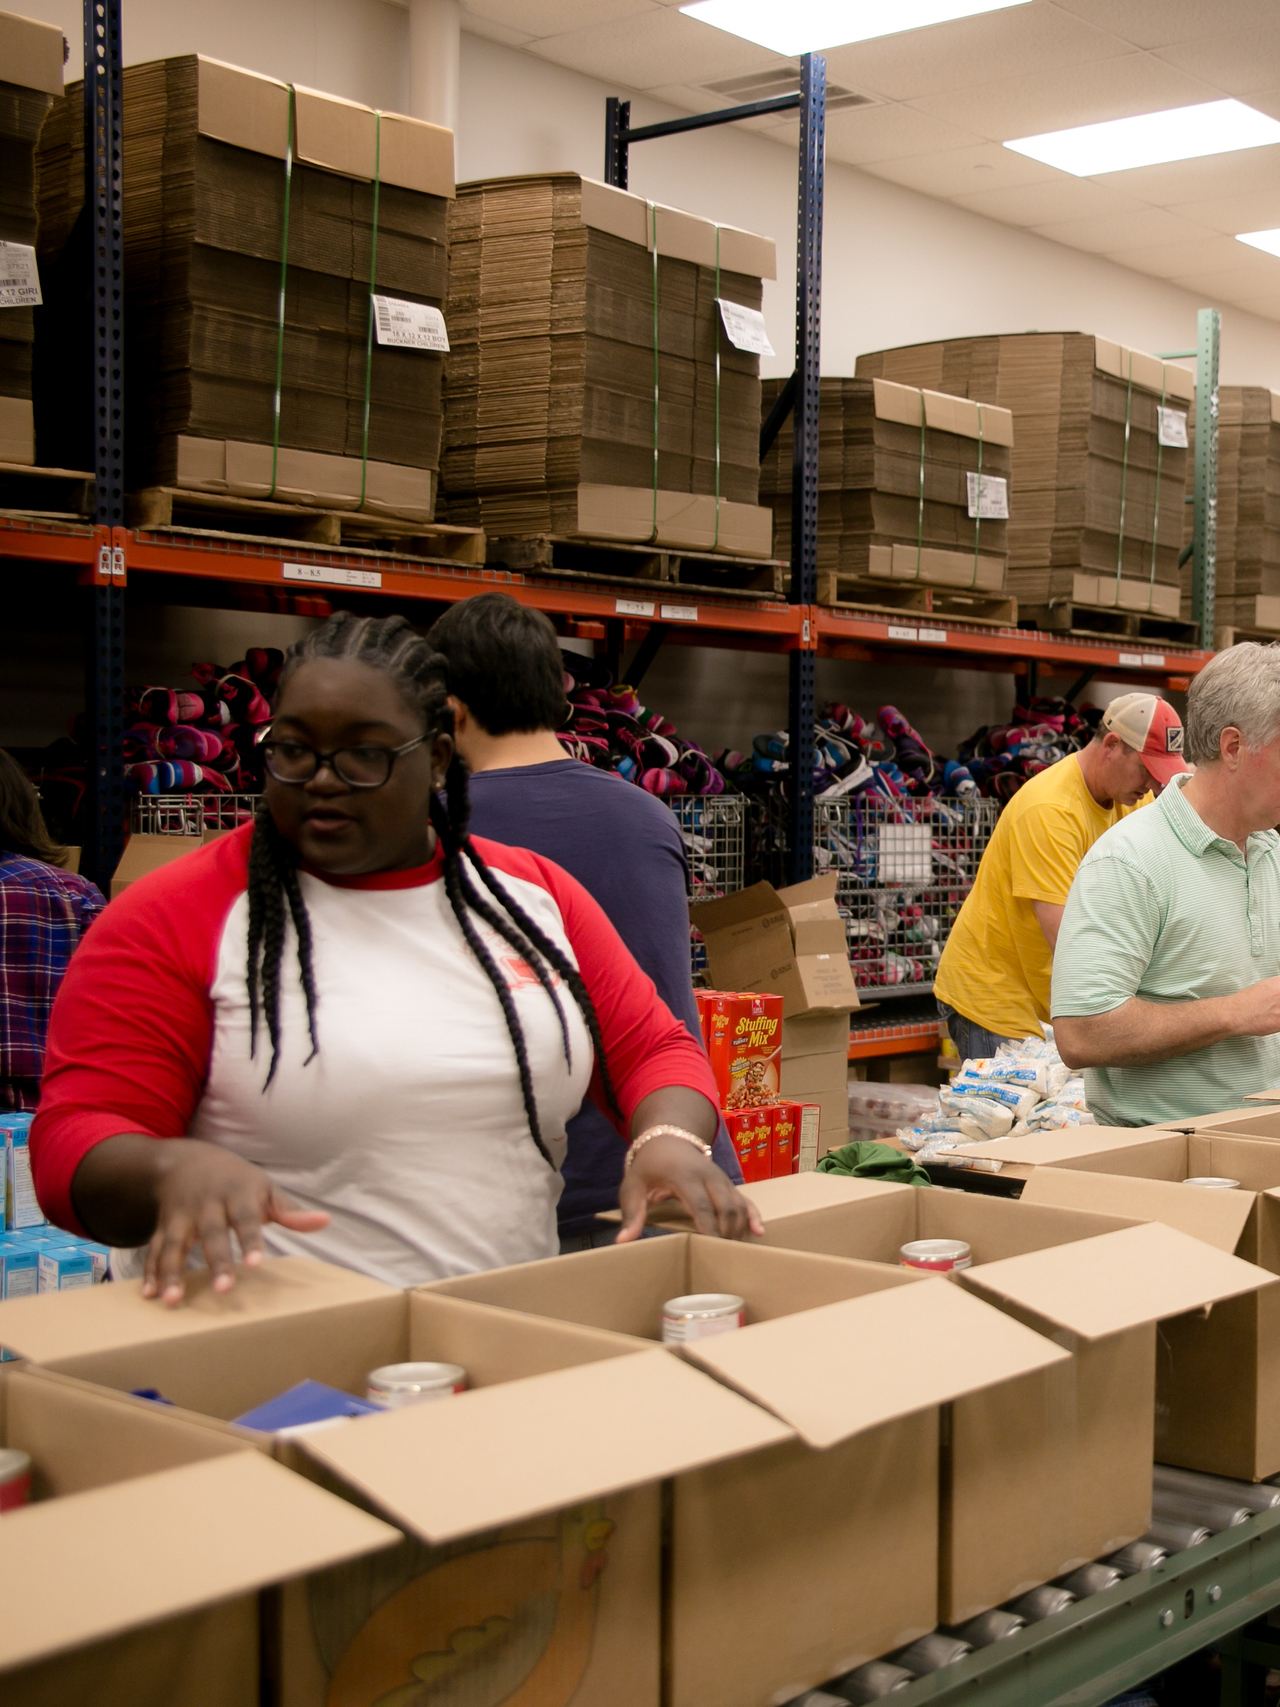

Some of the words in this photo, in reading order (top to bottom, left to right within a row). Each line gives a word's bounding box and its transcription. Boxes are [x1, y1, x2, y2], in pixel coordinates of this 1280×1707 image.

[0, 297, 37, 305] CHILDREN
[417, 340, 446, 349] CHILDREN
[735, 1016, 779, 1036] Stuffing
[748, 1031, 769, 1048] Mix
